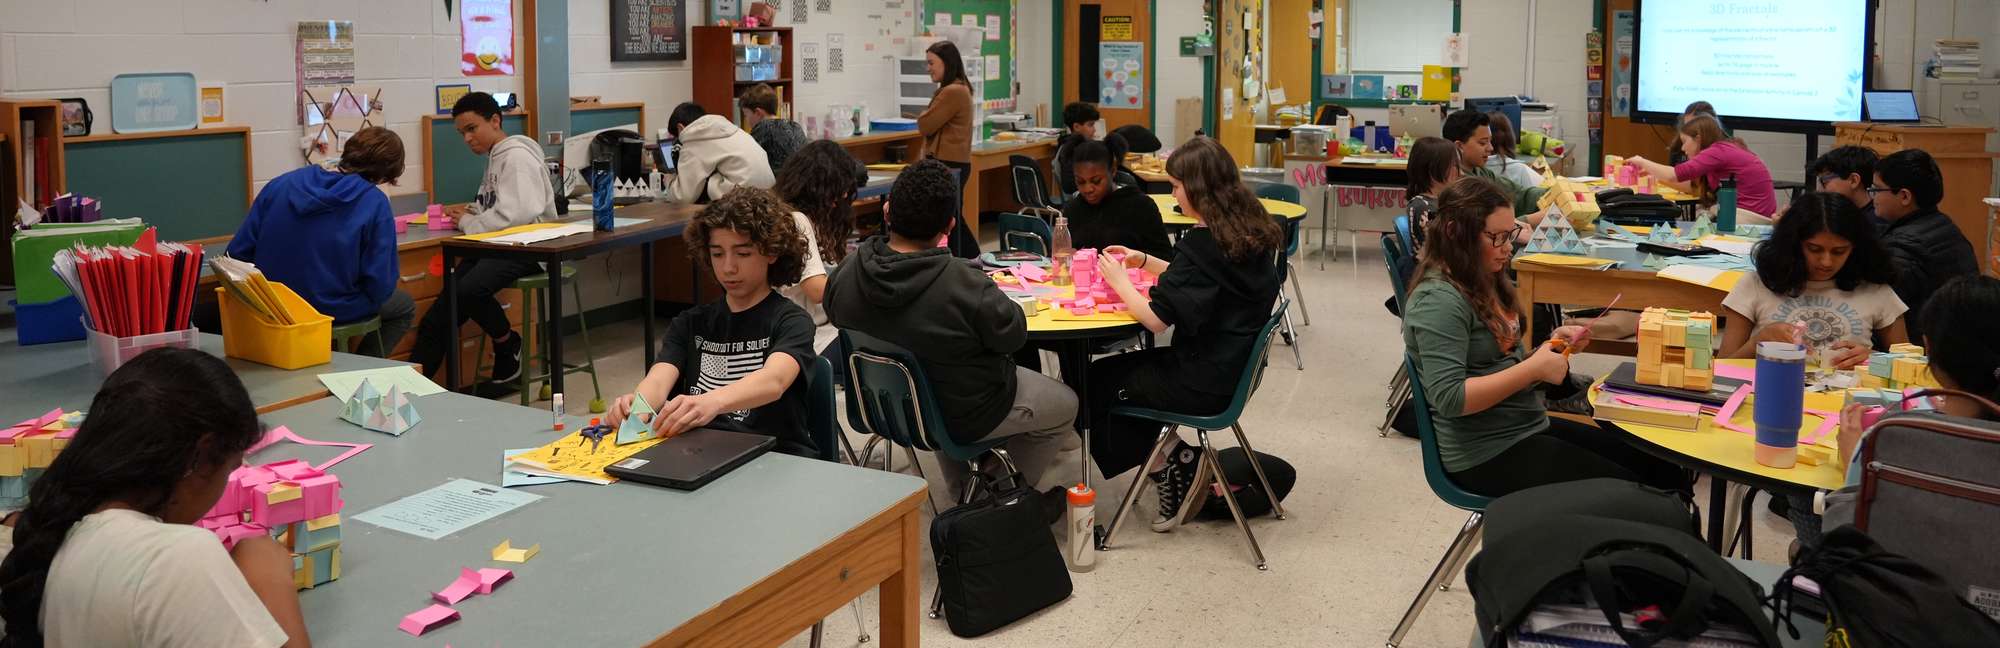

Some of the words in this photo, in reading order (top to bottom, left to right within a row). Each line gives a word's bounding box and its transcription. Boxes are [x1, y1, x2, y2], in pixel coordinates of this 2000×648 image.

[1709, 3, 1725, 15] 3D
[1729, 3, 1778, 14] Fractals
[1771, 295, 1834, 321] RATEFUL
[732, 342, 744, 352] FOR
